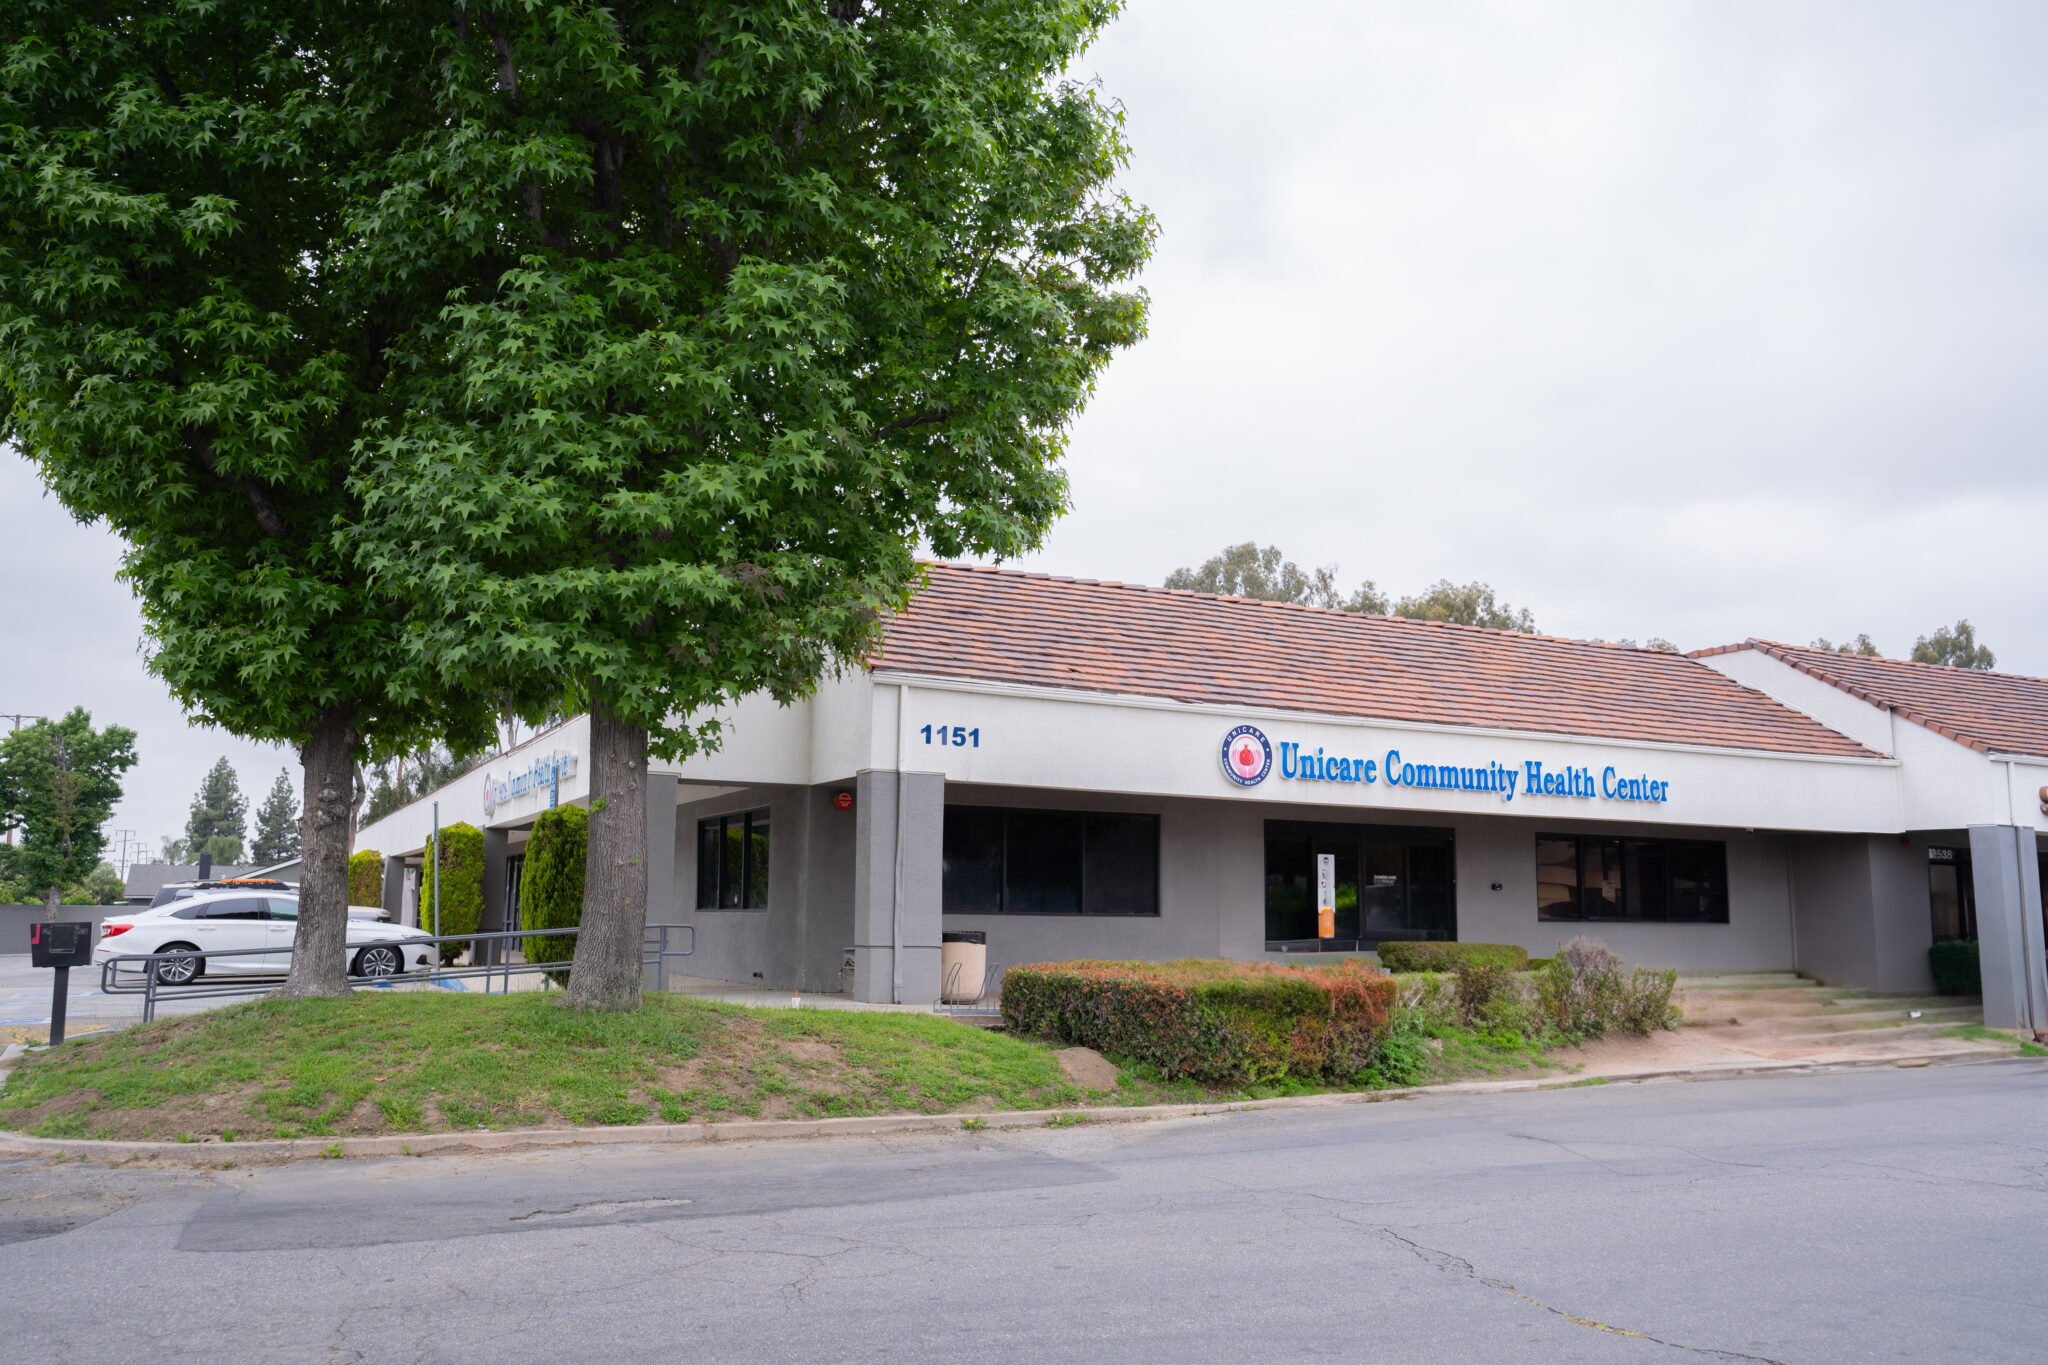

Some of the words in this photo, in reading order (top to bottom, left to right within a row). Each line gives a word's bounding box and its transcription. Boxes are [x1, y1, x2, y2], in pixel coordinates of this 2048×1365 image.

[921, 724, 979, 747] 1151
[1227, 727, 1265, 742] UNICARE
[1223, 758, 1243, 783] COMMUNITY
[1261, 759, 1270, 777] CENTER
[1280, 742, 1377, 783] Unicare
[1385, 750, 1519, 801] Community
[1525, 761, 1596, 797] Health
[1602, 766, 1669, 801] Center
